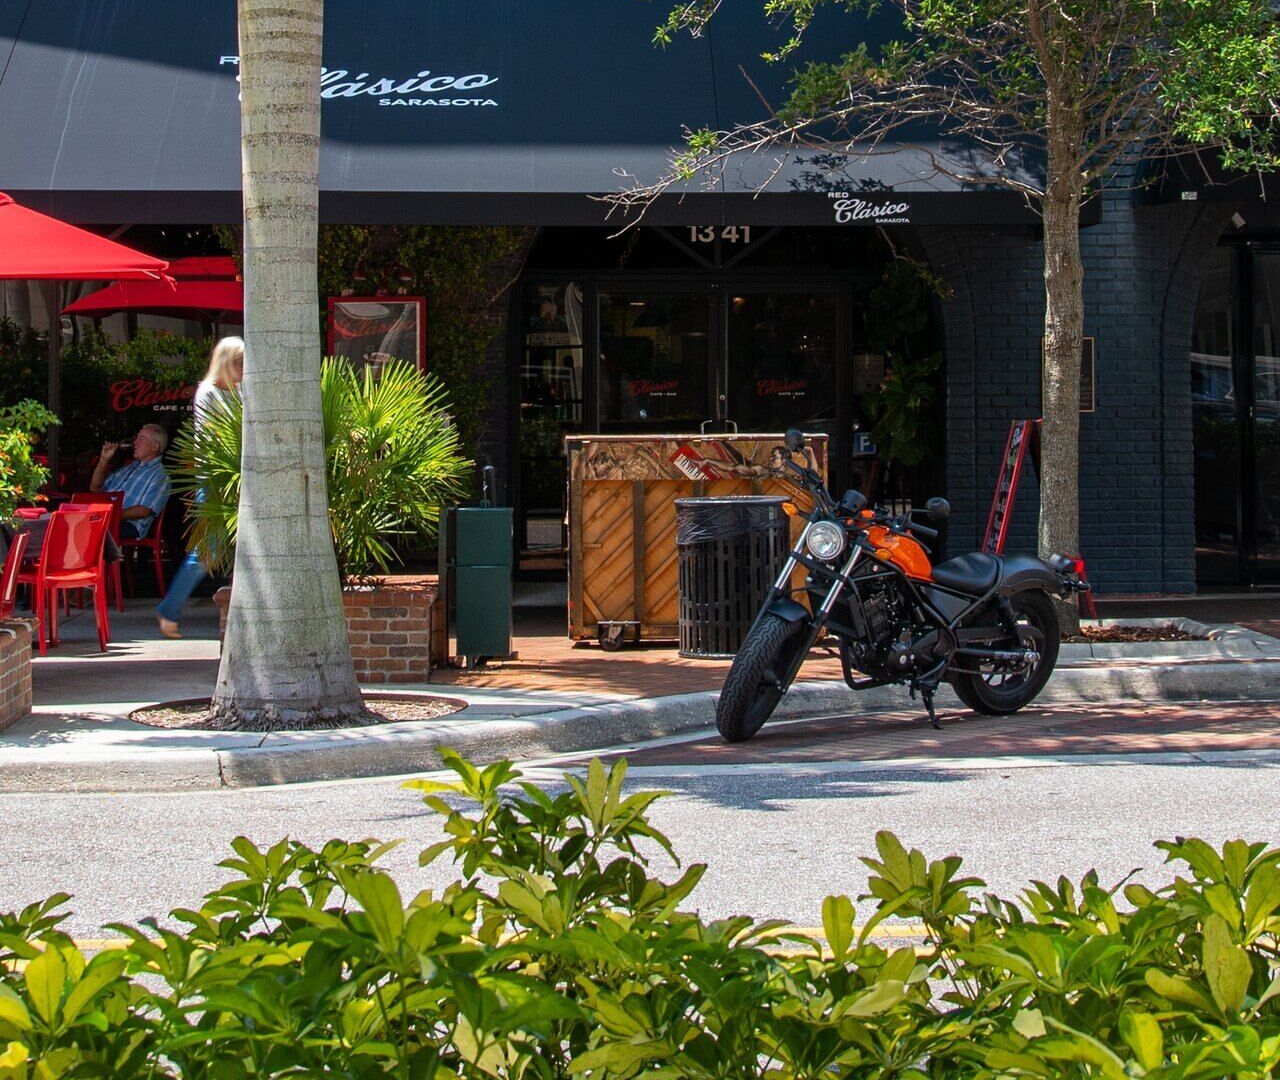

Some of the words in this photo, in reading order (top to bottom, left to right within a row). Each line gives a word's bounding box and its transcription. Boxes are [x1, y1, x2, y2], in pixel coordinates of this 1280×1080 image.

[236, 67, 499, 100] lásico
[379, 98, 499, 107] SARASOTA
[833, 198, 910, 223] Clásico
